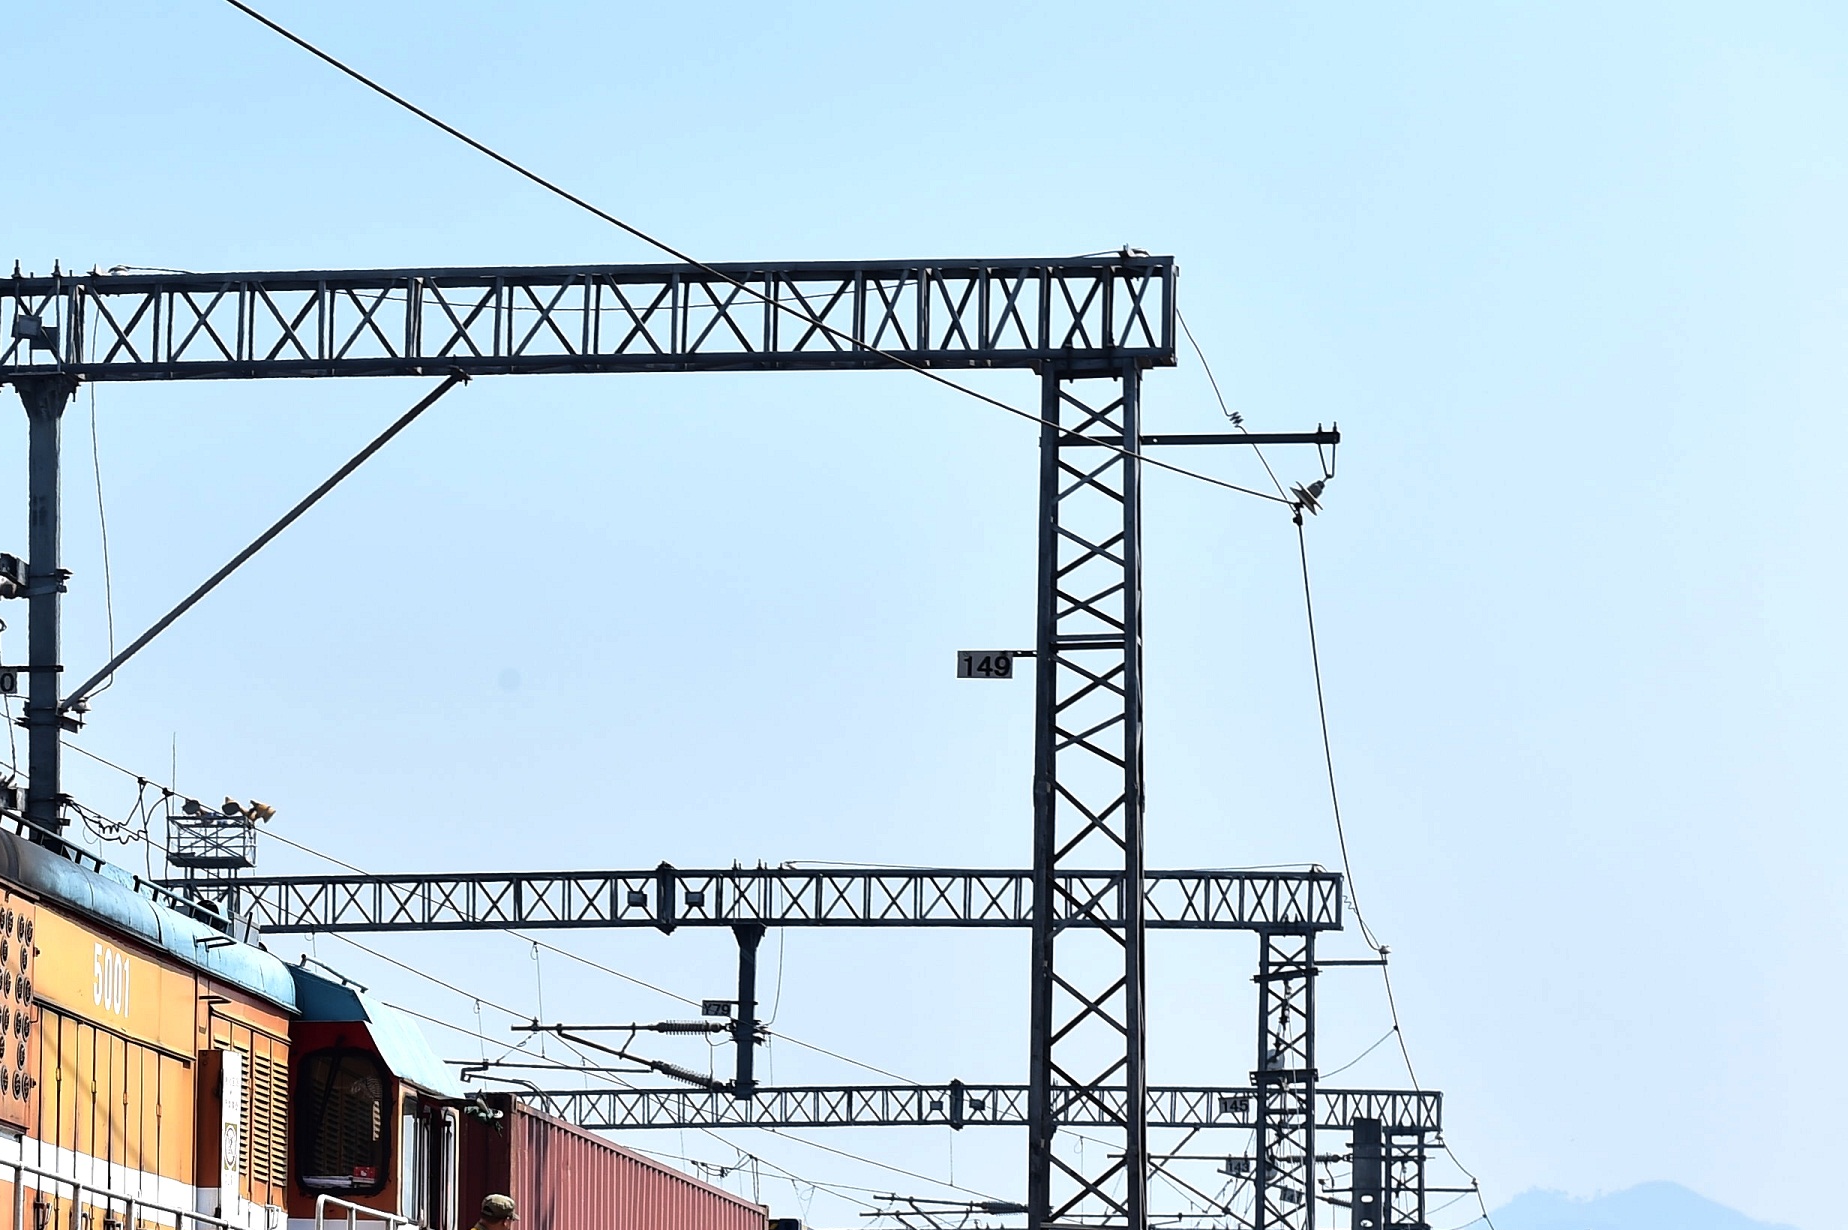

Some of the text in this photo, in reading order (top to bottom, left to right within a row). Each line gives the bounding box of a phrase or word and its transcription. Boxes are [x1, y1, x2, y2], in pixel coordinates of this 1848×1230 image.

[963, 655, 1011, 677] 149
[93, 942, 131, 1019] 5001
[703, 1003, 731, 1016] Y79
[1221, 1100, 1249, 1113] 145
[1227, 1160, 1250, 1174] 143
